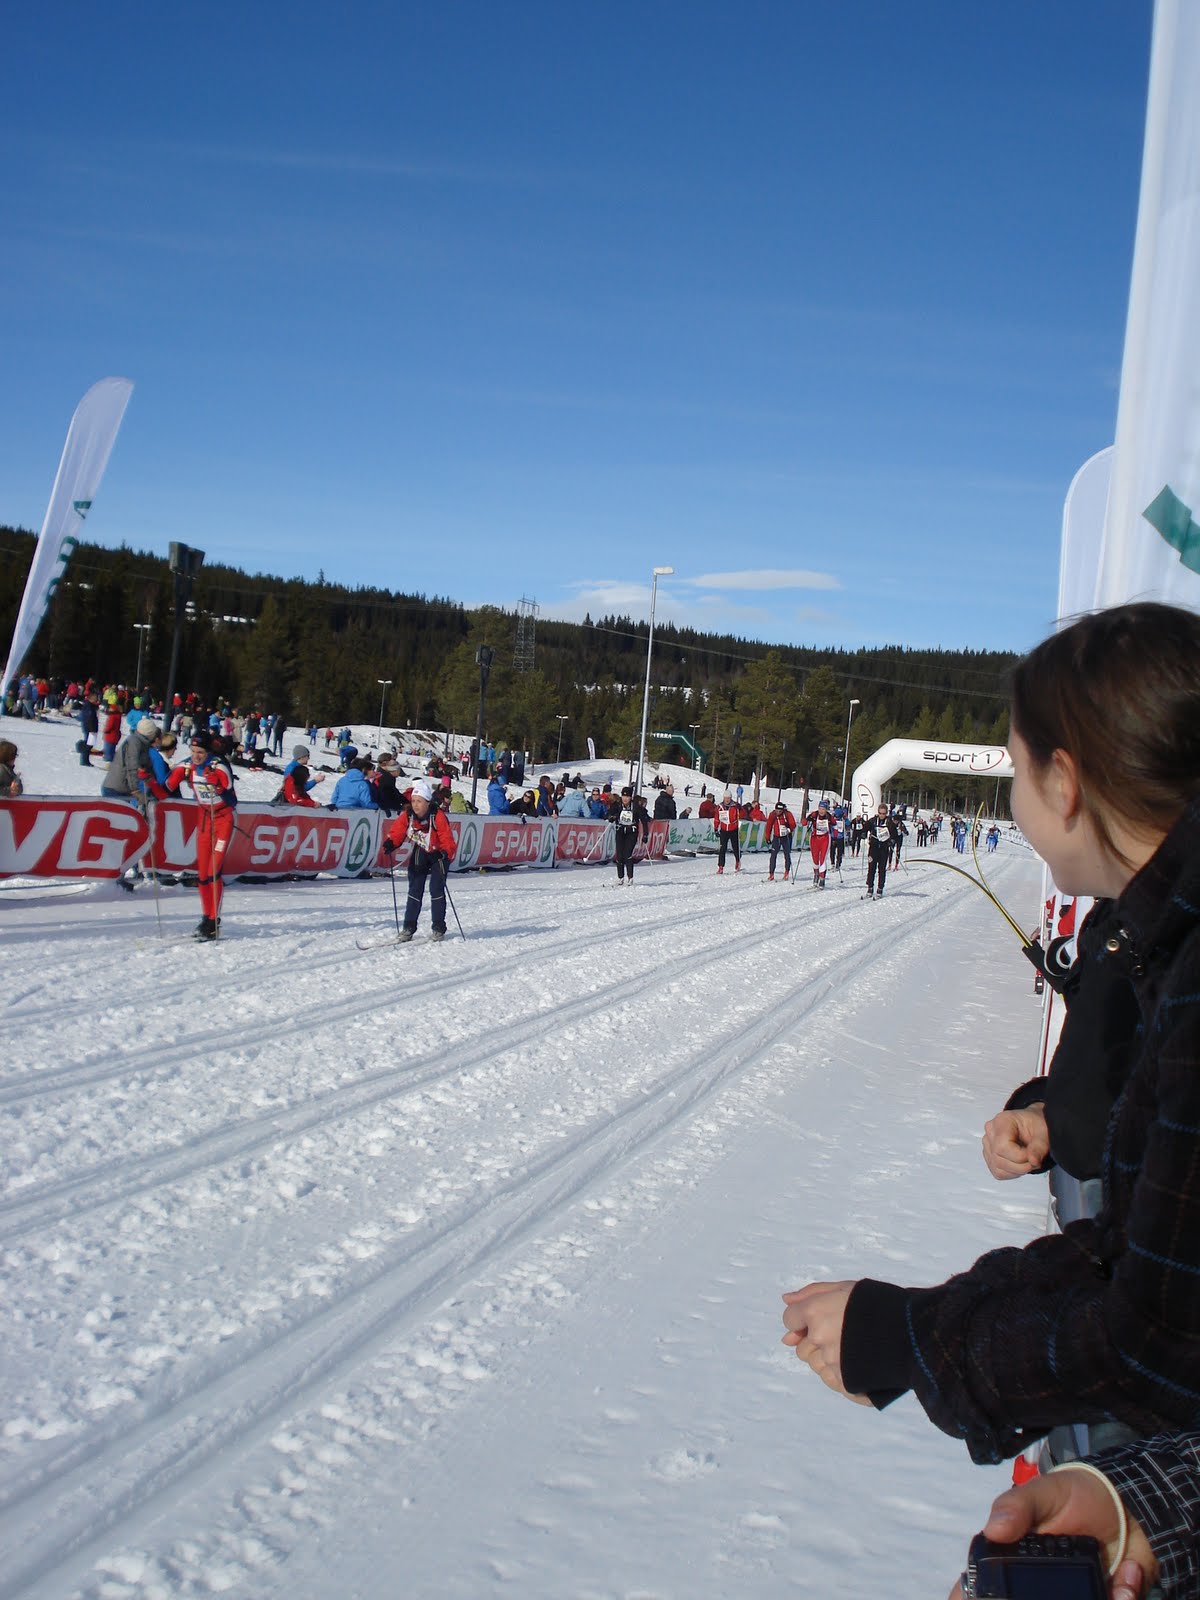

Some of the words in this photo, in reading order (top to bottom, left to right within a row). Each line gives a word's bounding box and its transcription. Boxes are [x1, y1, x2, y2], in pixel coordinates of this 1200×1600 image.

[923, 750, 977, 763] sport
[985, 753, 991, 764] 1
[0, 809, 139, 873] VG
[251, 825, 346, 864] SPAR
[491, 830, 541, 858] SPAR
